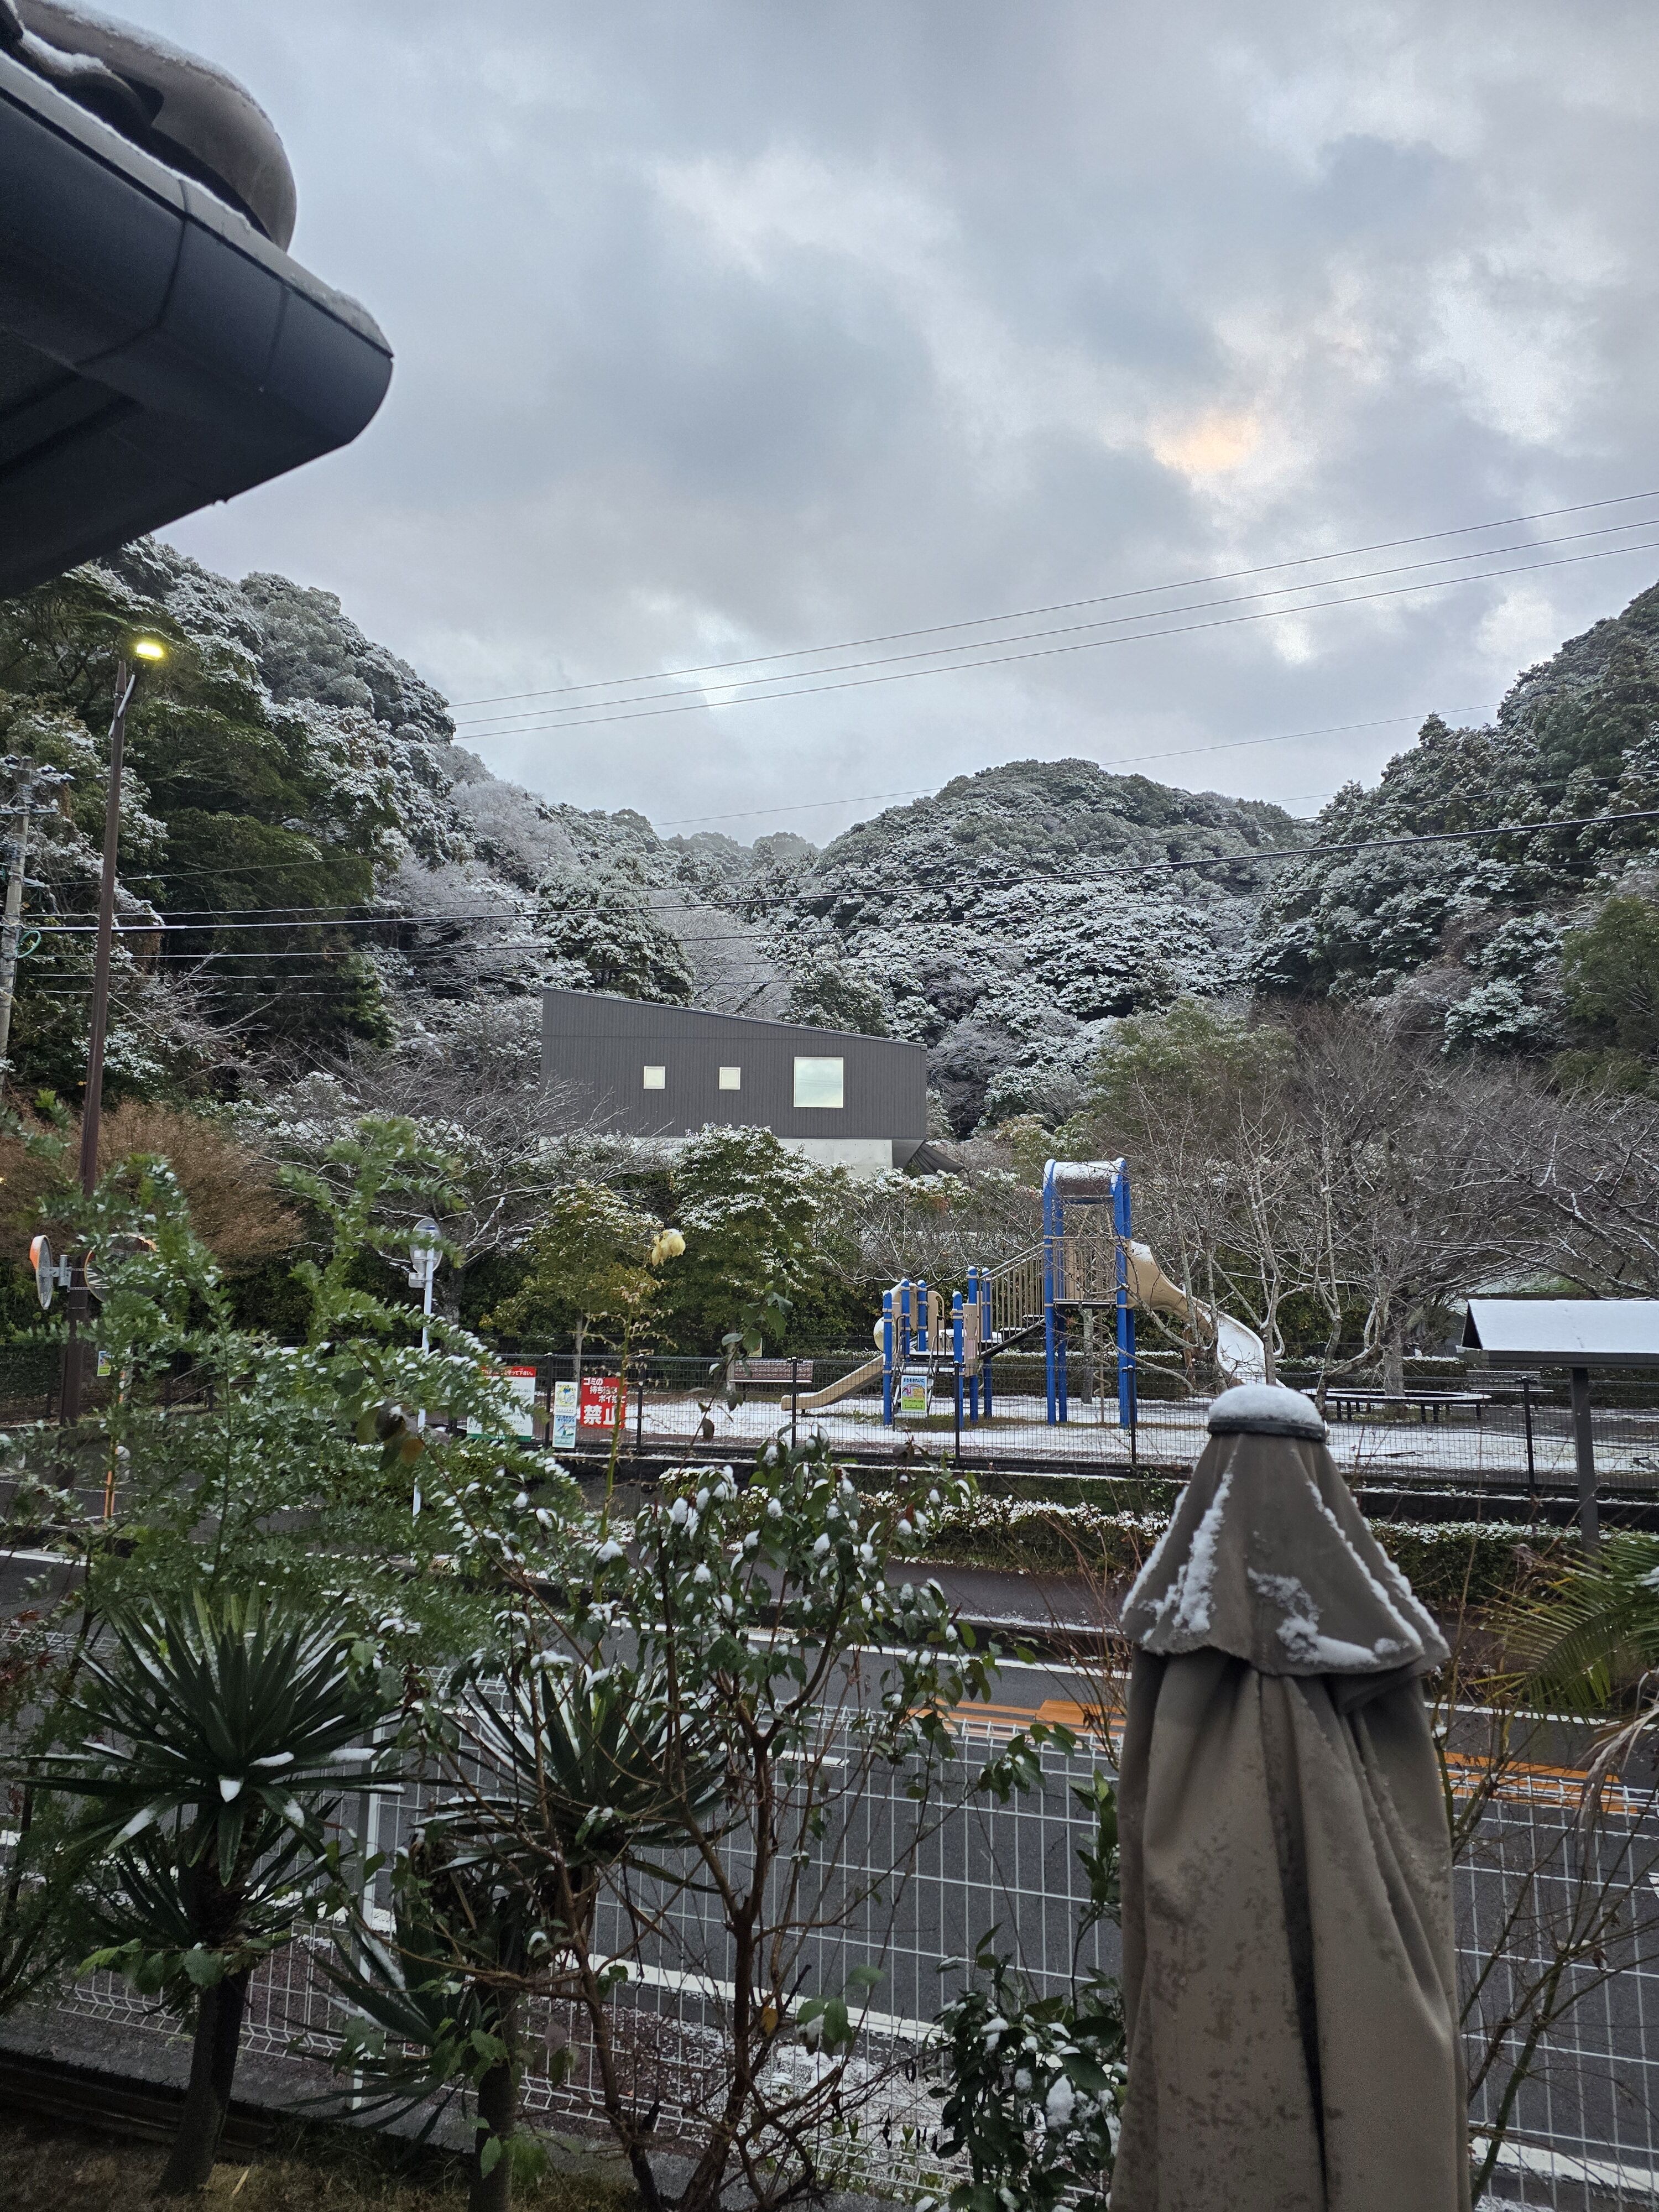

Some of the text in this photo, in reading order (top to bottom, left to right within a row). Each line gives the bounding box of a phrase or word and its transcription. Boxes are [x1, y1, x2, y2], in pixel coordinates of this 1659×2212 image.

[583, 1377, 603, 1385] ゴミの
[583, 1405, 621, 1425] 禁止
